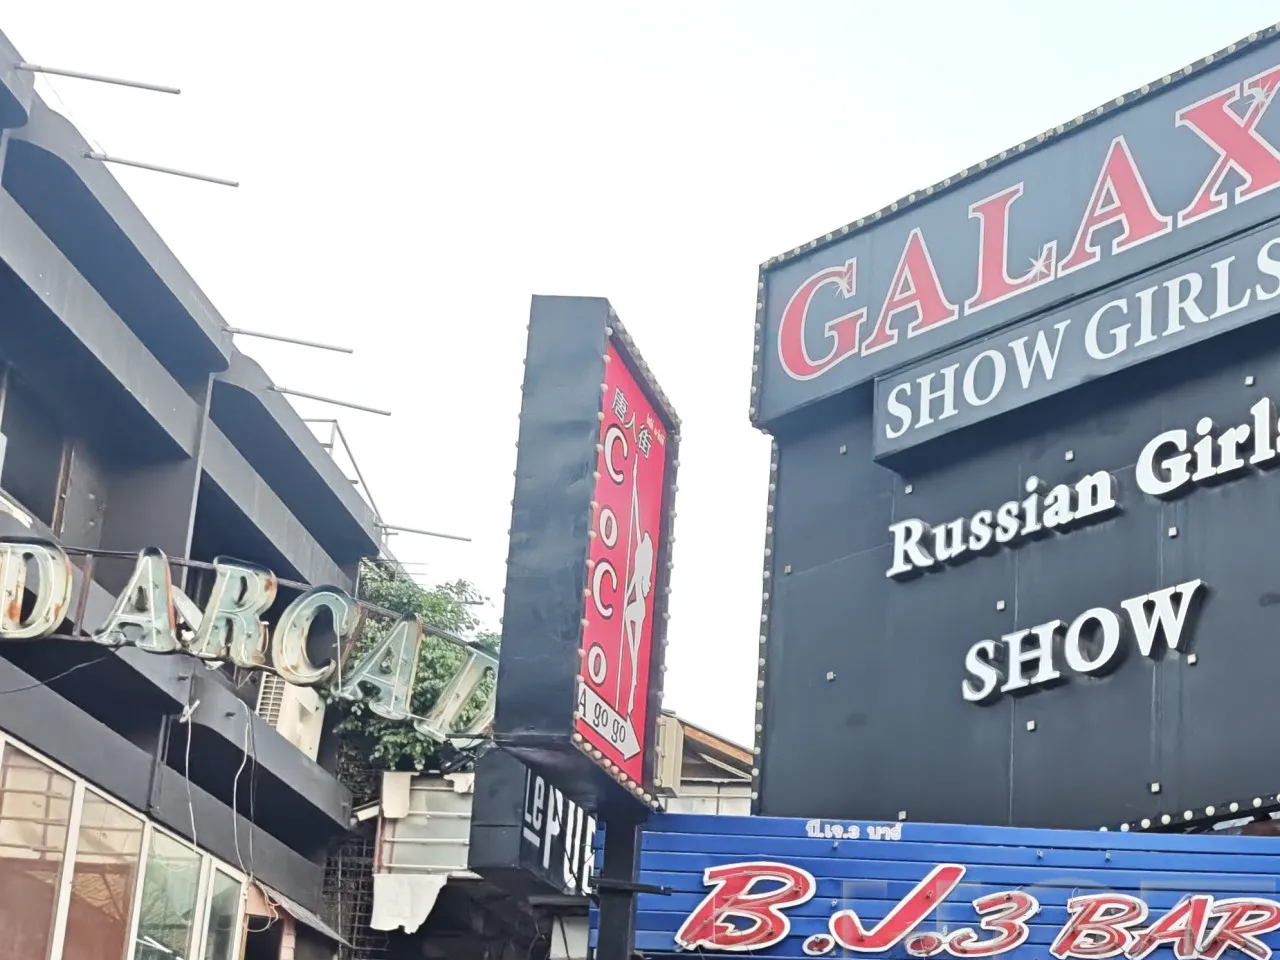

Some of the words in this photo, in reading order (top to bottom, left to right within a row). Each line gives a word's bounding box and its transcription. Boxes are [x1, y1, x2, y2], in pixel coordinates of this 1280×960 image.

[885, 319, 1071, 439] SHOW
[886, 469, 1118, 577] Russian
[962, 579, 1204, 702] SHOW
[578, 690, 588, 719] A
